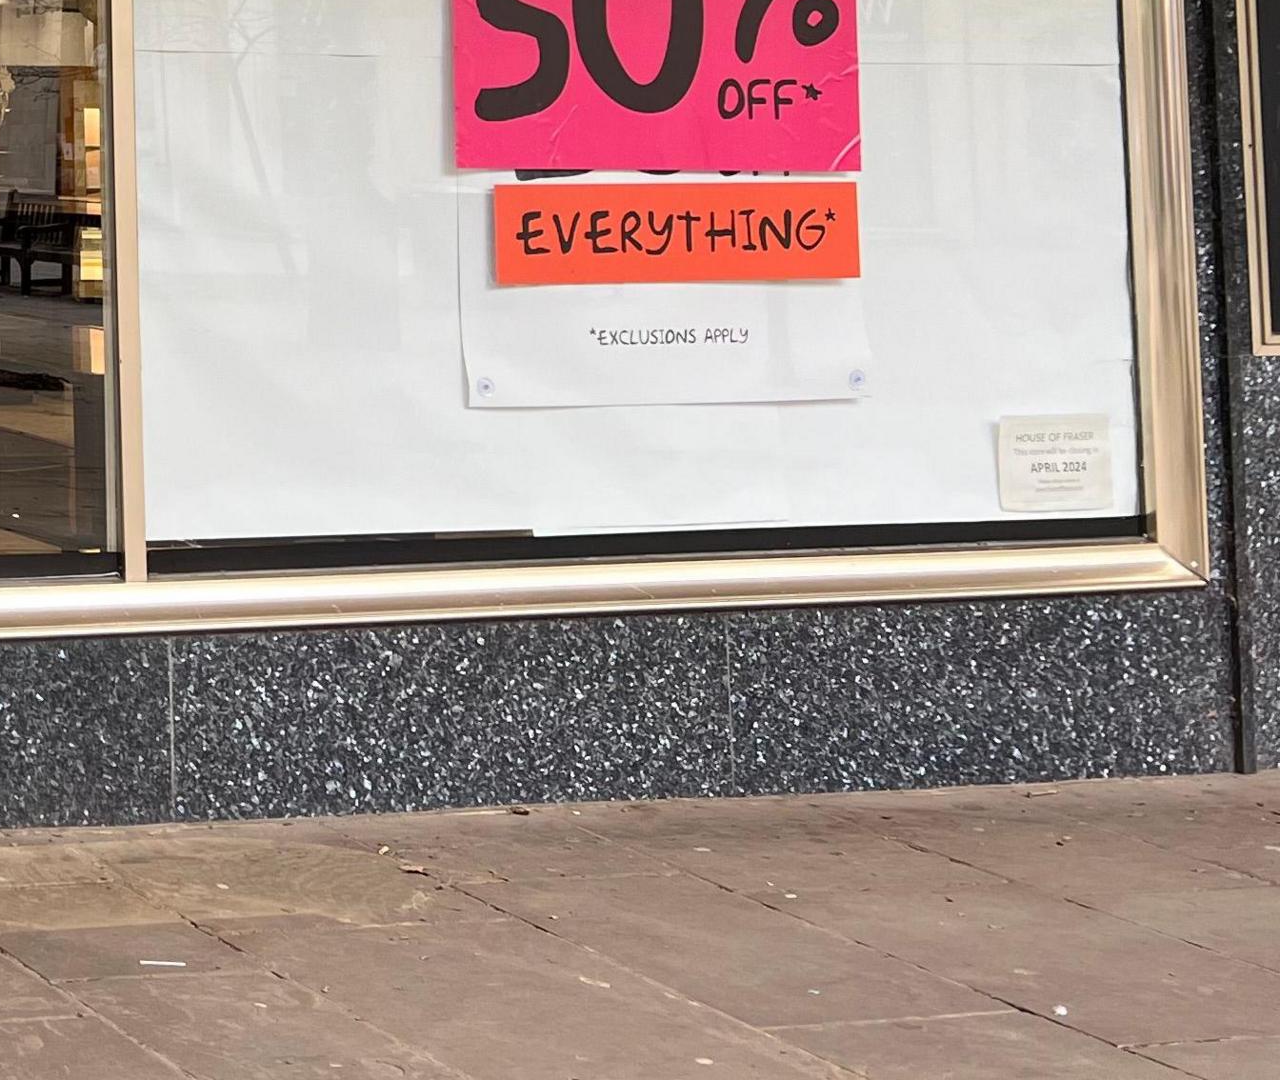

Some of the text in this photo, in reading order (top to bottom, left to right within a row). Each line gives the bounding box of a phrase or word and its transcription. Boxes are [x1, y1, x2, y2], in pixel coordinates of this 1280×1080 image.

[703, 326, 749, 345] APPLY
[1016, 431, 1095, 442] HOUSE OF FRASER
[1030, 460, 1088, 473] APRIL 2024
